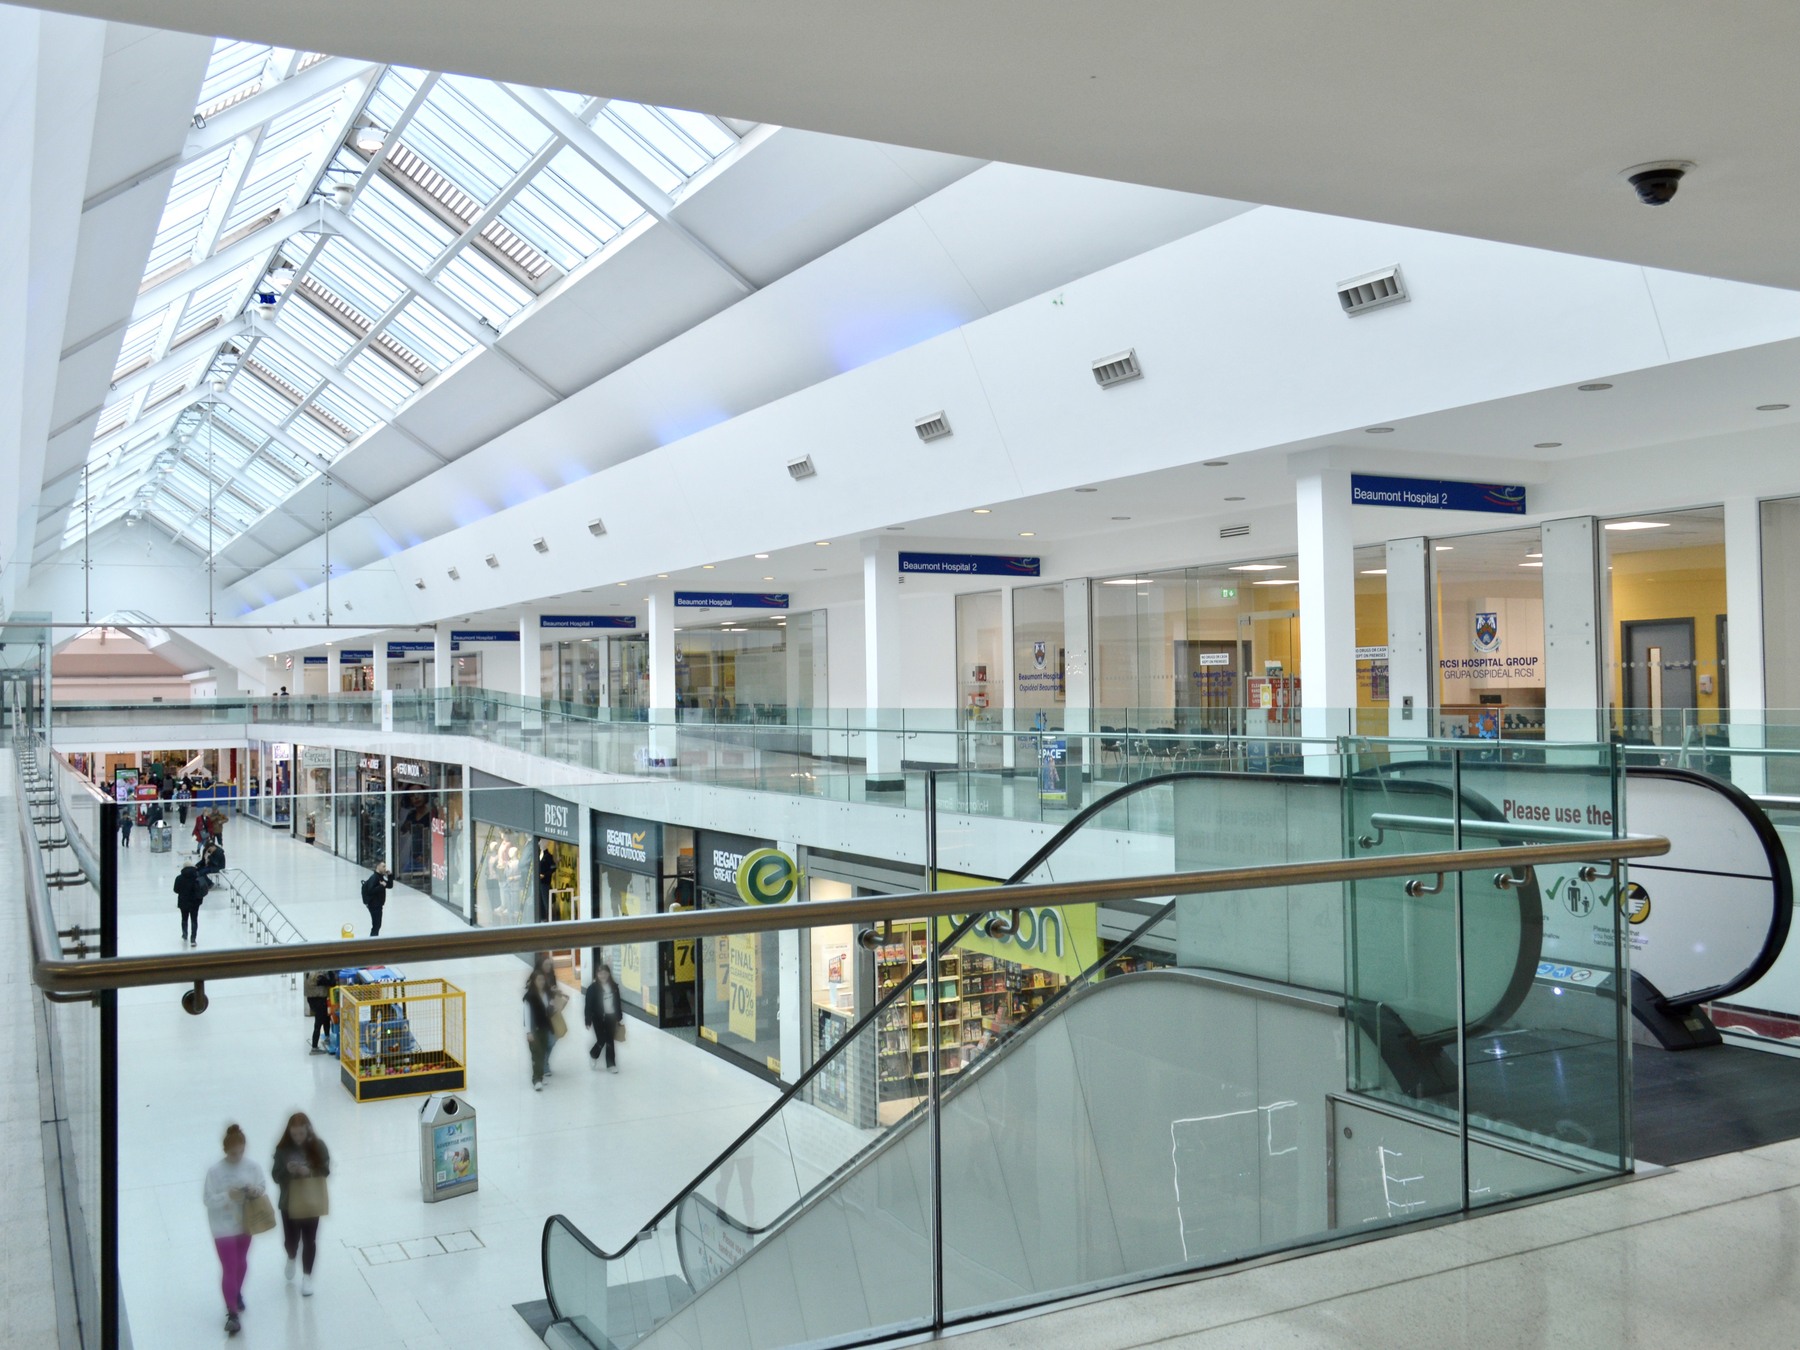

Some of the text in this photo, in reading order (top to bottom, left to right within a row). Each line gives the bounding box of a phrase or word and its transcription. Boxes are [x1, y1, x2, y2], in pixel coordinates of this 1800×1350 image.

[1354, 487, 1448, 505] Beaumont Hospital 2
[903, 561, 978, 573] Beaumont Hospital 2
[677, 598, 733, 607] Beaumont Hospital
[1440, 657, 1538, 669] RCSI HOSPITAL GROUP
[1018, 673, 1042, 681] Beaumont
[1444, 668, 1534, 679] GRÚPA OSPIDÉAL RCSI
[544, 803, 568, 828] BEST
[1503, 799, 1612, 826] Please use the
[432, 817, 444, 835] SALE
[607, 829, 633, 848] REGATTA
[607, 844, 646, 863] GREAT OUTDOORS
[713, 849, 745, 870] REGATT
[713, 867, 732, 883] GREAT
[731, 948, 753, 971] FINAL
[731, 966, 754, 982] CLEARANCE
[731, 982, 754, 1015] 70%
[448, 1122, 463, 1136] DM
